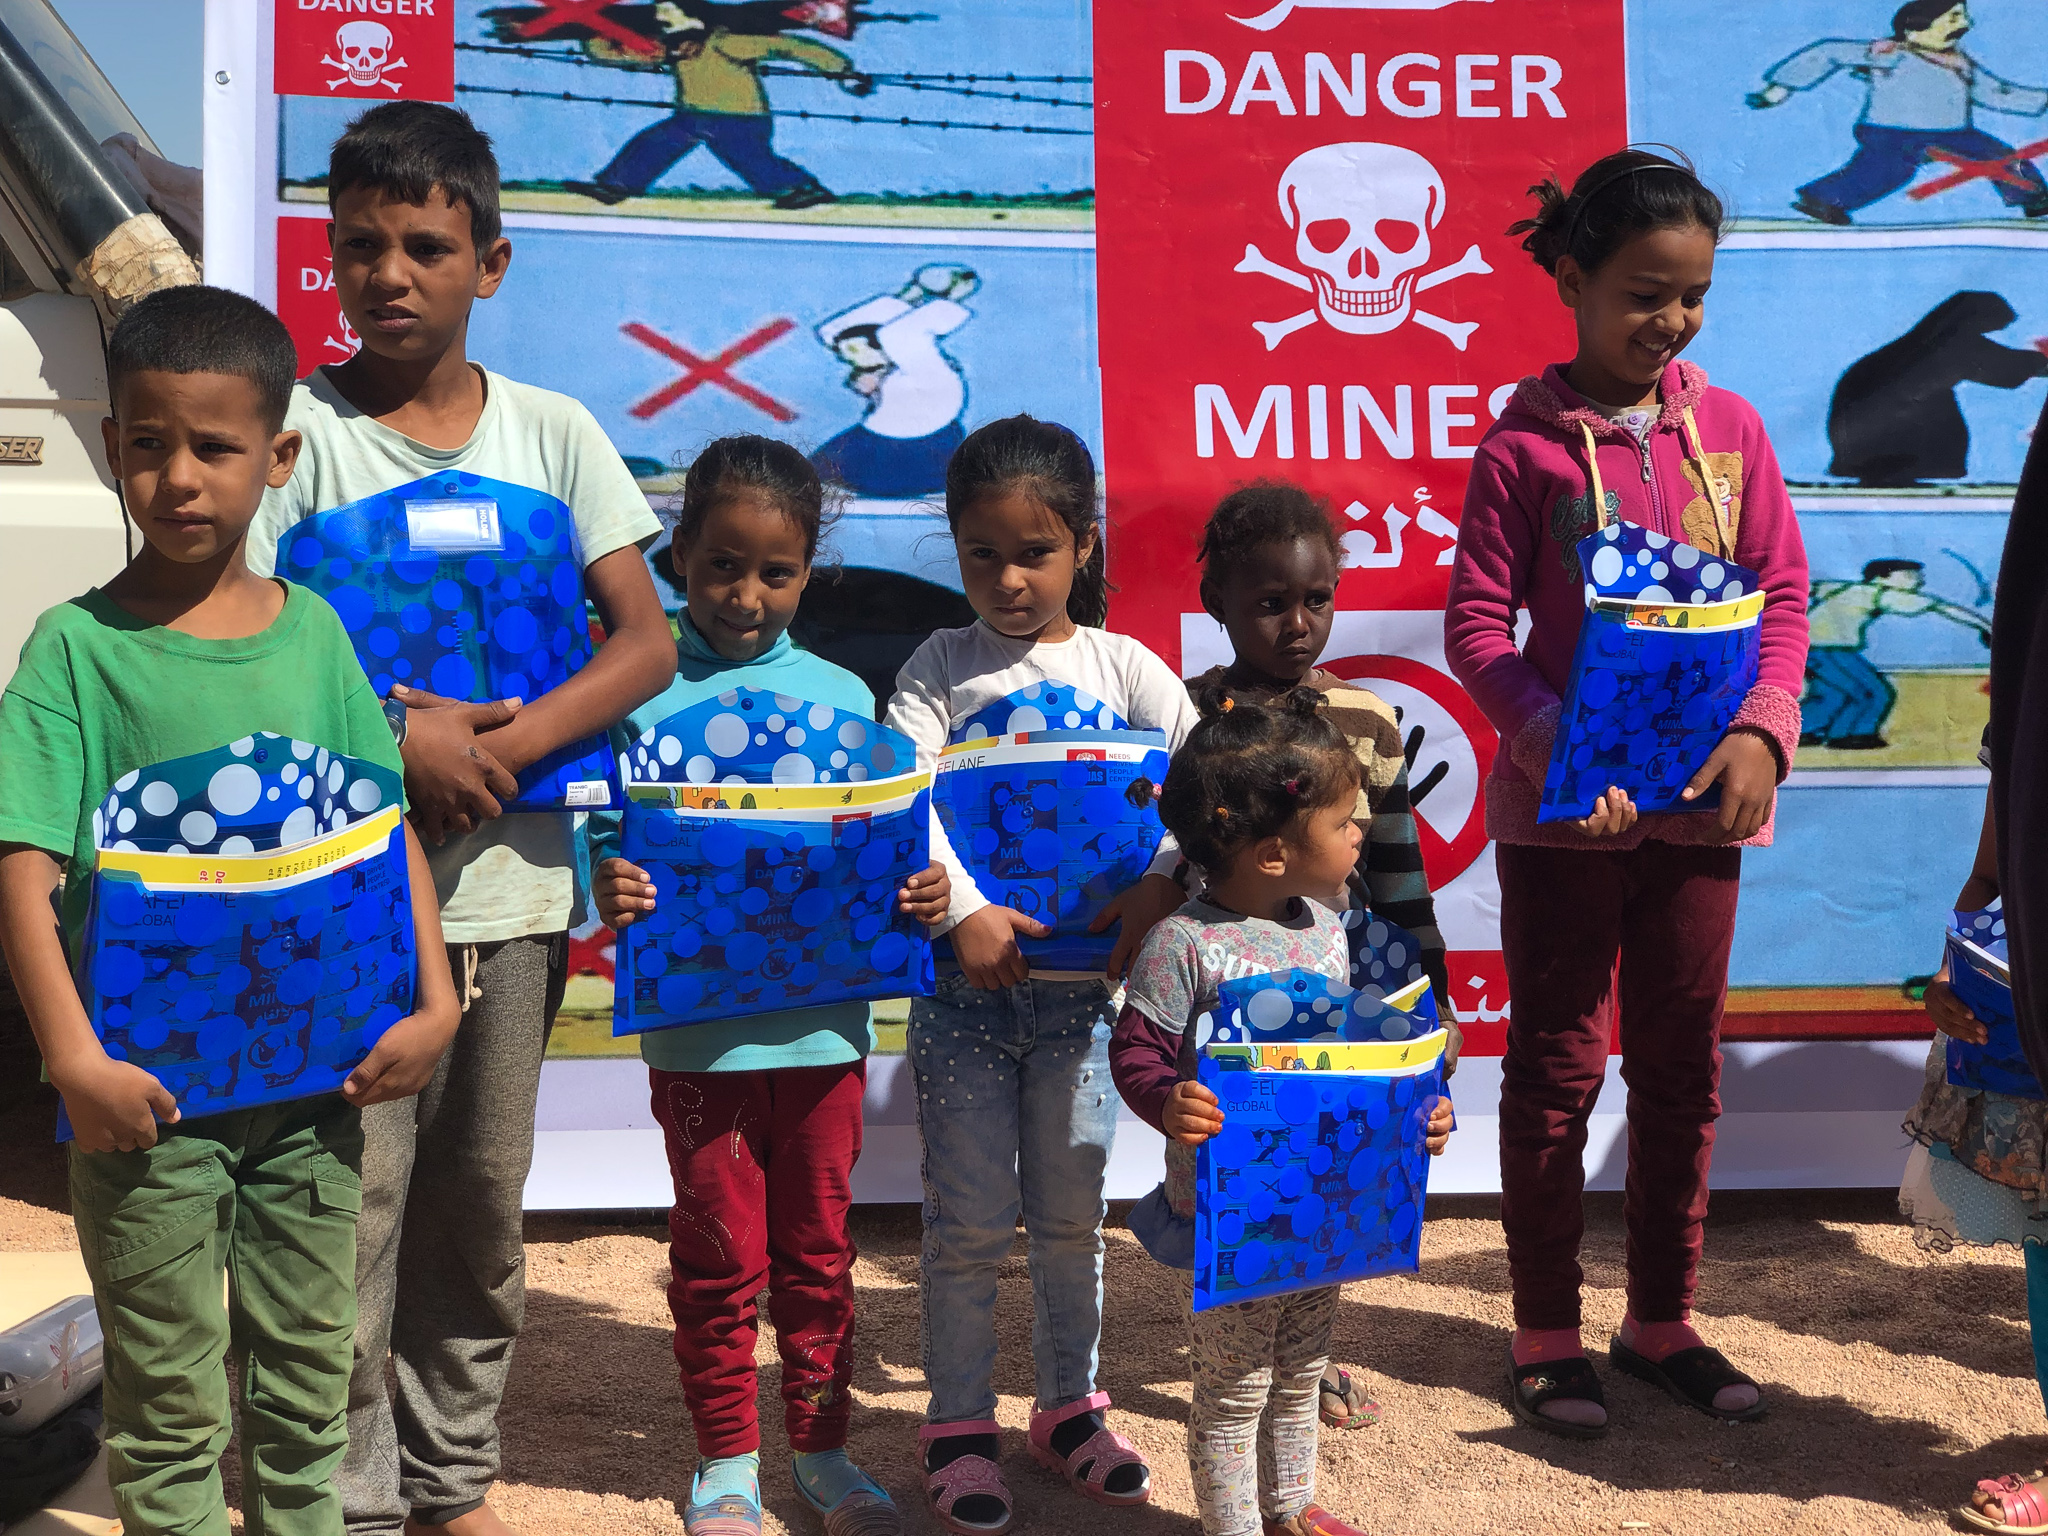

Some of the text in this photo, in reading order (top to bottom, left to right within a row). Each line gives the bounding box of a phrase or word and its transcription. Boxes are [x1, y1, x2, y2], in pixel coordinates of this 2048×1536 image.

[1163, 49, 1568, 119] DANGER
[937, 755, 986, 776] FELANE
[646, 836, 692, 847] GBAL
[199, 870, 209, 882] et
[215, 871, 226, 884] De
[1226, 1100, 1273, 1112] GLOBAL
[1320, 1180, 1343, 1194] MIN
